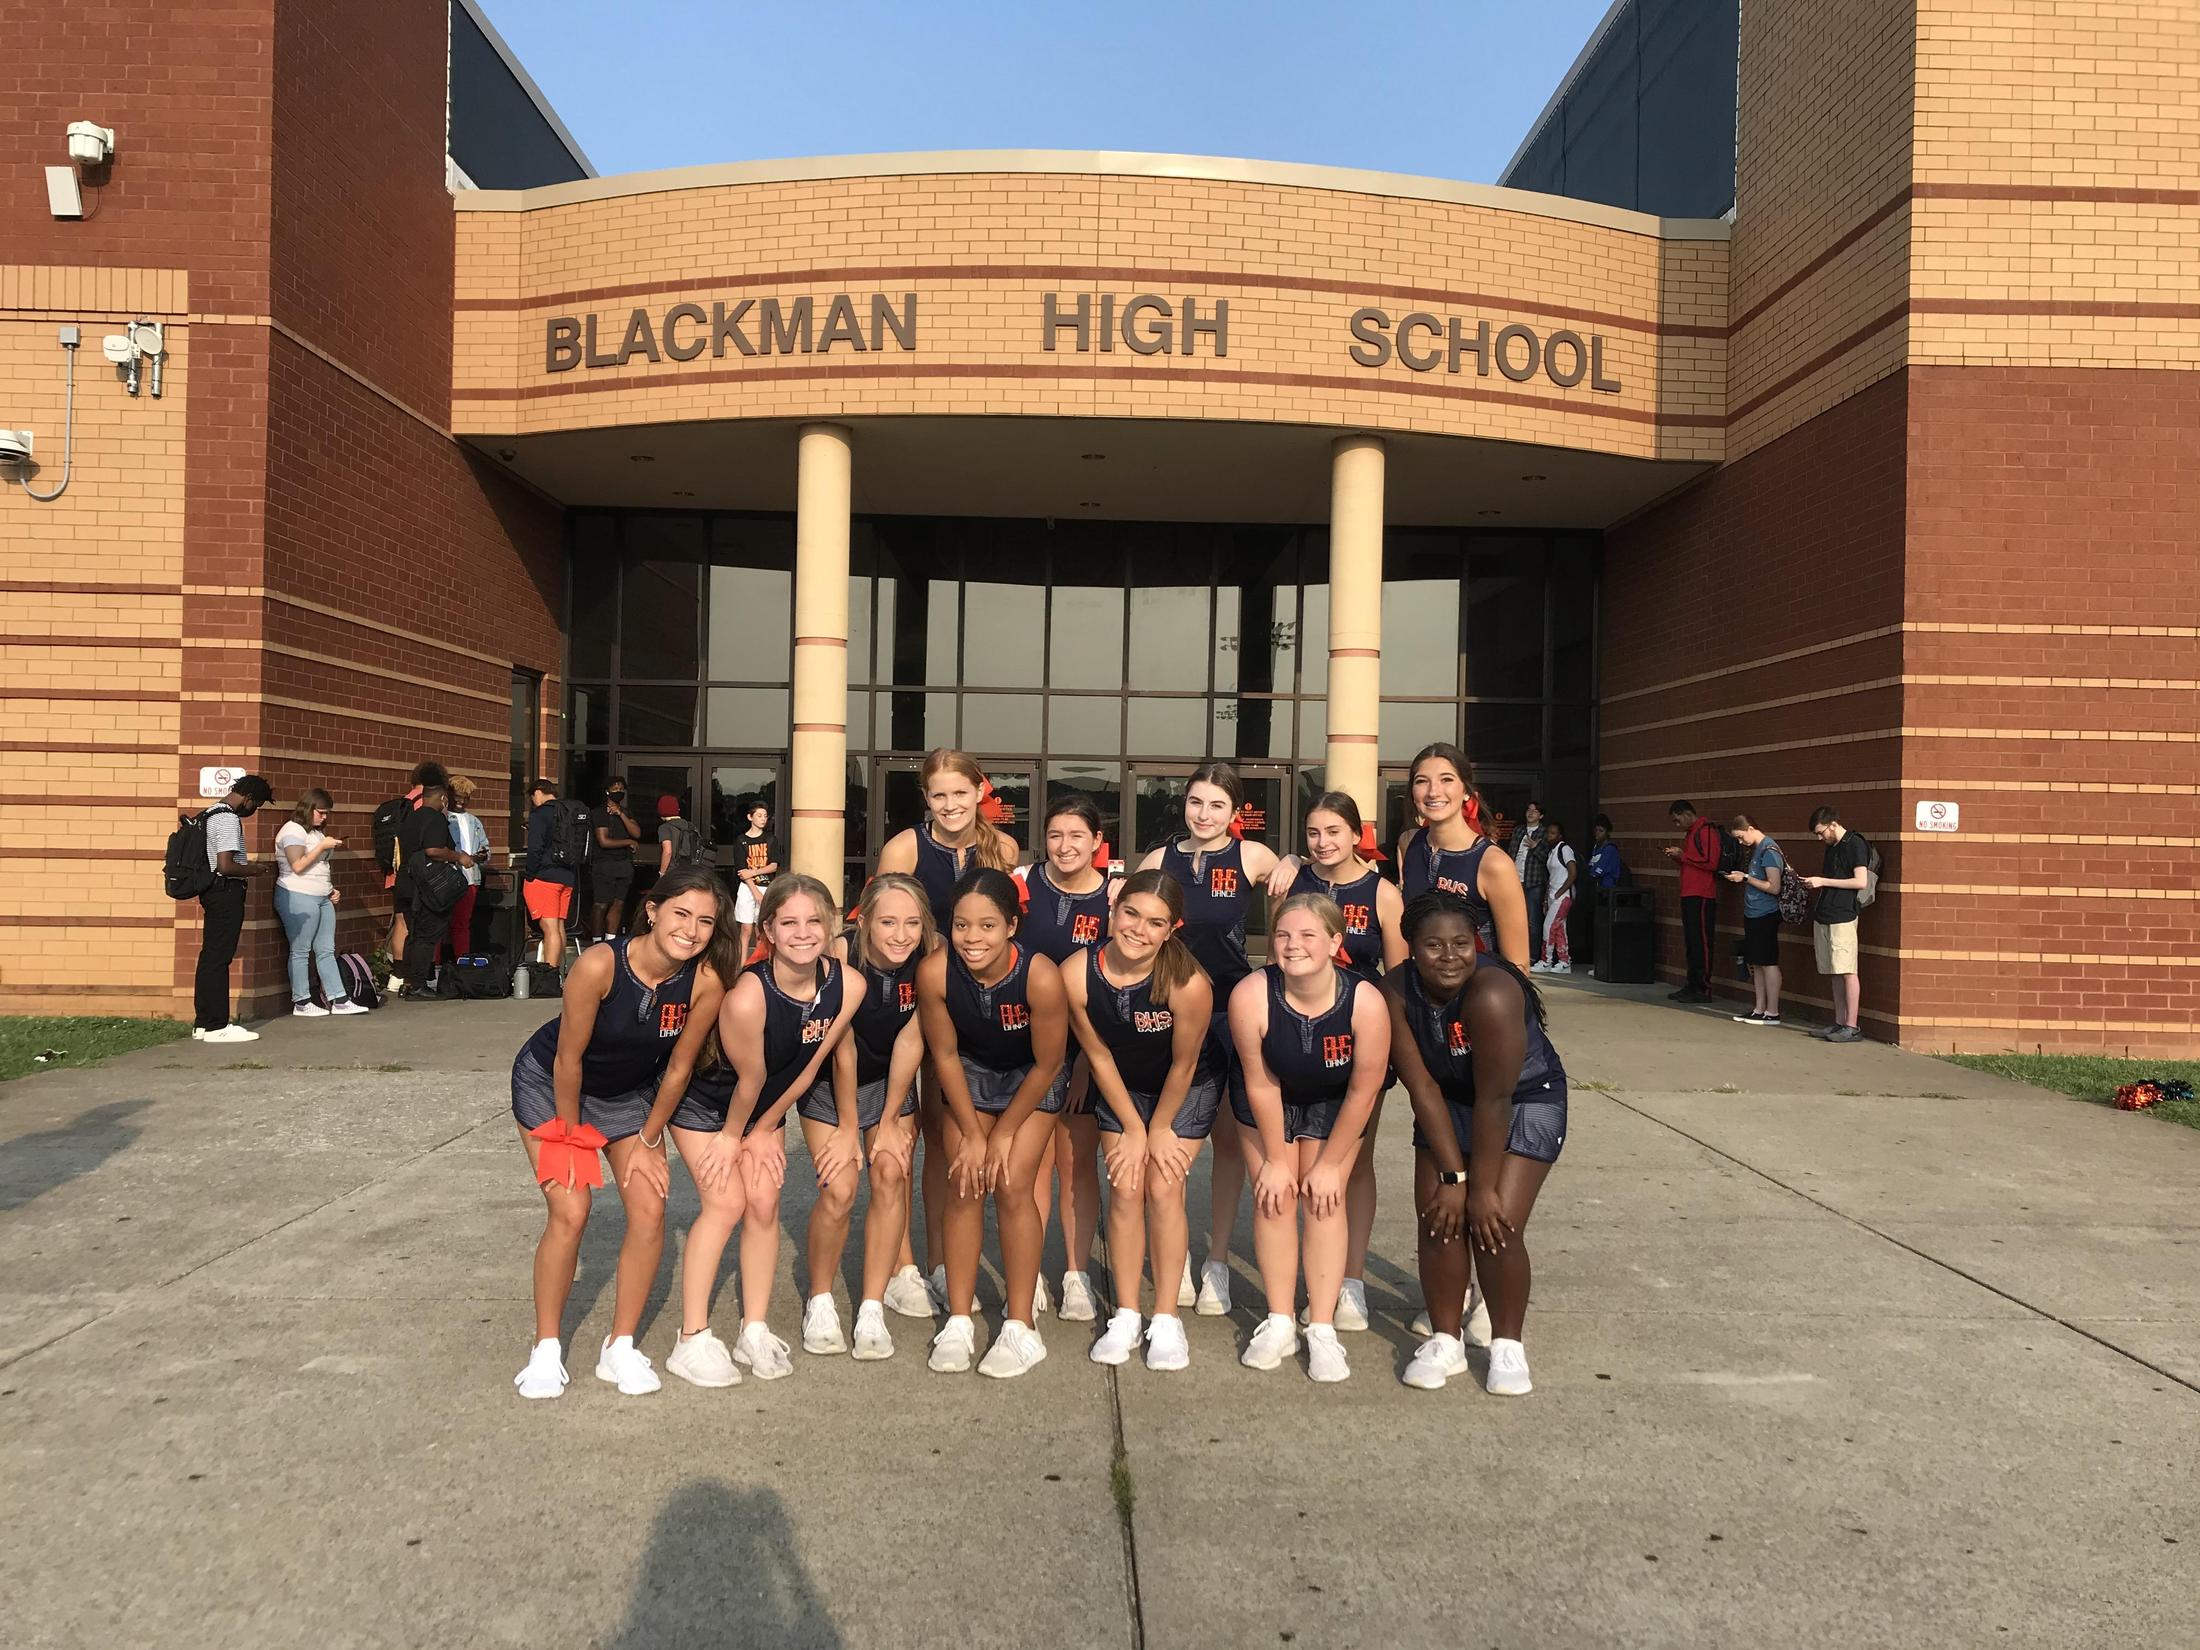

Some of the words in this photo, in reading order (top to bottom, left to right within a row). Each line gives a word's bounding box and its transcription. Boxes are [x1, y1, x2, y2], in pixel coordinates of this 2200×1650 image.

[546, 293, 917, 374] BLACKMAN
[1043, 293, 1229, 357] HIGH
[1349, 308, 1621, 393] SCHOOL
[203, 787, 212, 795] NO
[1919, 820, 1928, 829] NO
[1929, 821, 1957, 830] SMOKING
[1211, 867, 1237, 890] BHS
[1211, 889, 1236, 898] DANCE
[1073, 912, 1100, 940] BHS
[1345, 927, 1367, 935] ANCE
[900, 1002, 916, 1013] DAN
[1133, 1010, 1173, 1029] BHS
[802, 1036, 824, 1044] DAN
[1322, 1035, 1353, 1061] BHS
